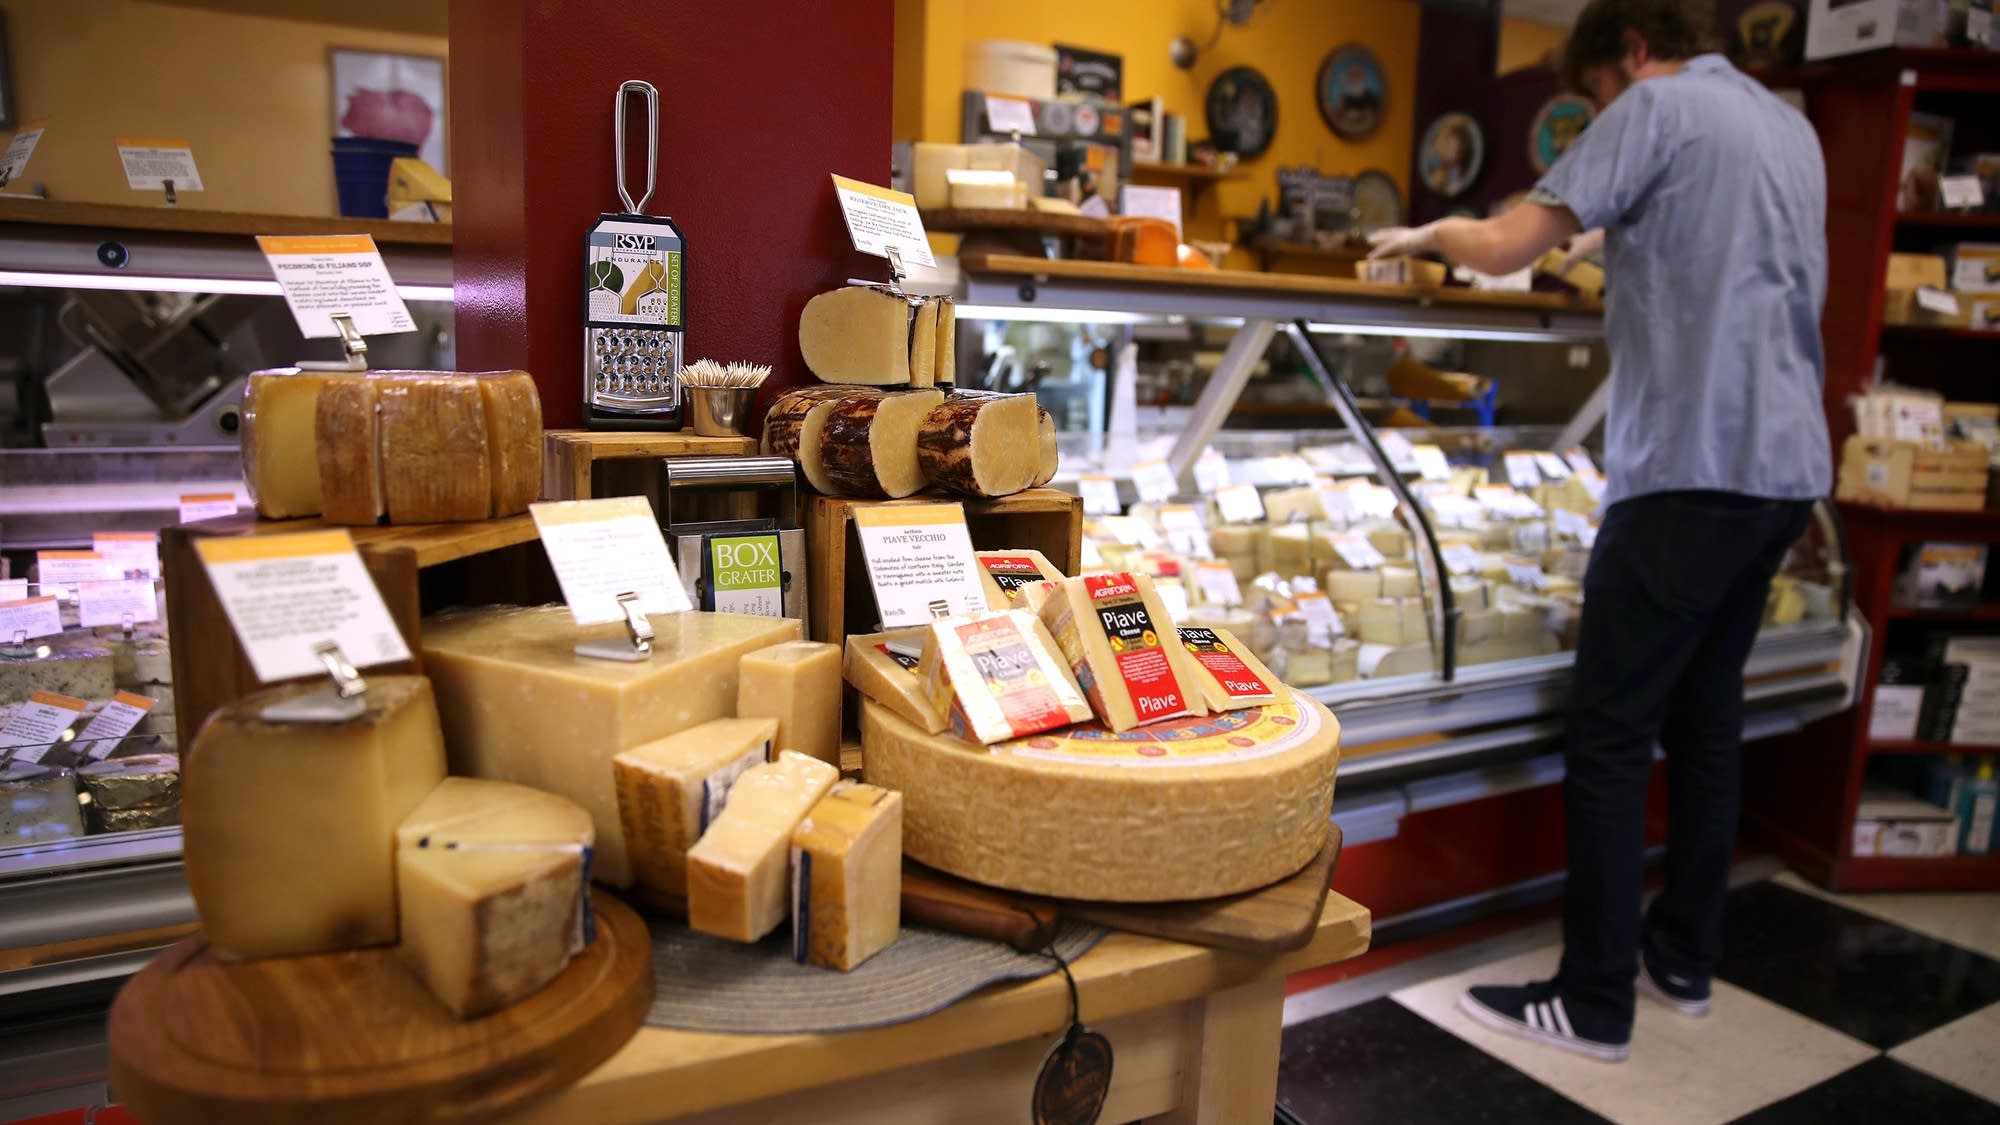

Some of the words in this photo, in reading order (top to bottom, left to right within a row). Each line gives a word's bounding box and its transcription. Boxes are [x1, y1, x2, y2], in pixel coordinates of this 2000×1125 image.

[615, 234, 655, 250] RSVP
[671, 270, 678, 283] OF
[883, 535, 908, 544] PIAVE
[909, 534, 947, 543] VECCHIO
[717, 542, 775, 569] BOX
[719, 569, 776, 586] GRATER
[1094, 584, 1135, 599] AGRIFORM
[1102, 610, 1148, 630] Piave
[1120, 628, 1141, 637] Cheese
[977, 650, 1033, 673] Piave
[1224, 680, 1262, 692] Piave
[1138, 694, 1178, 714] Piave
